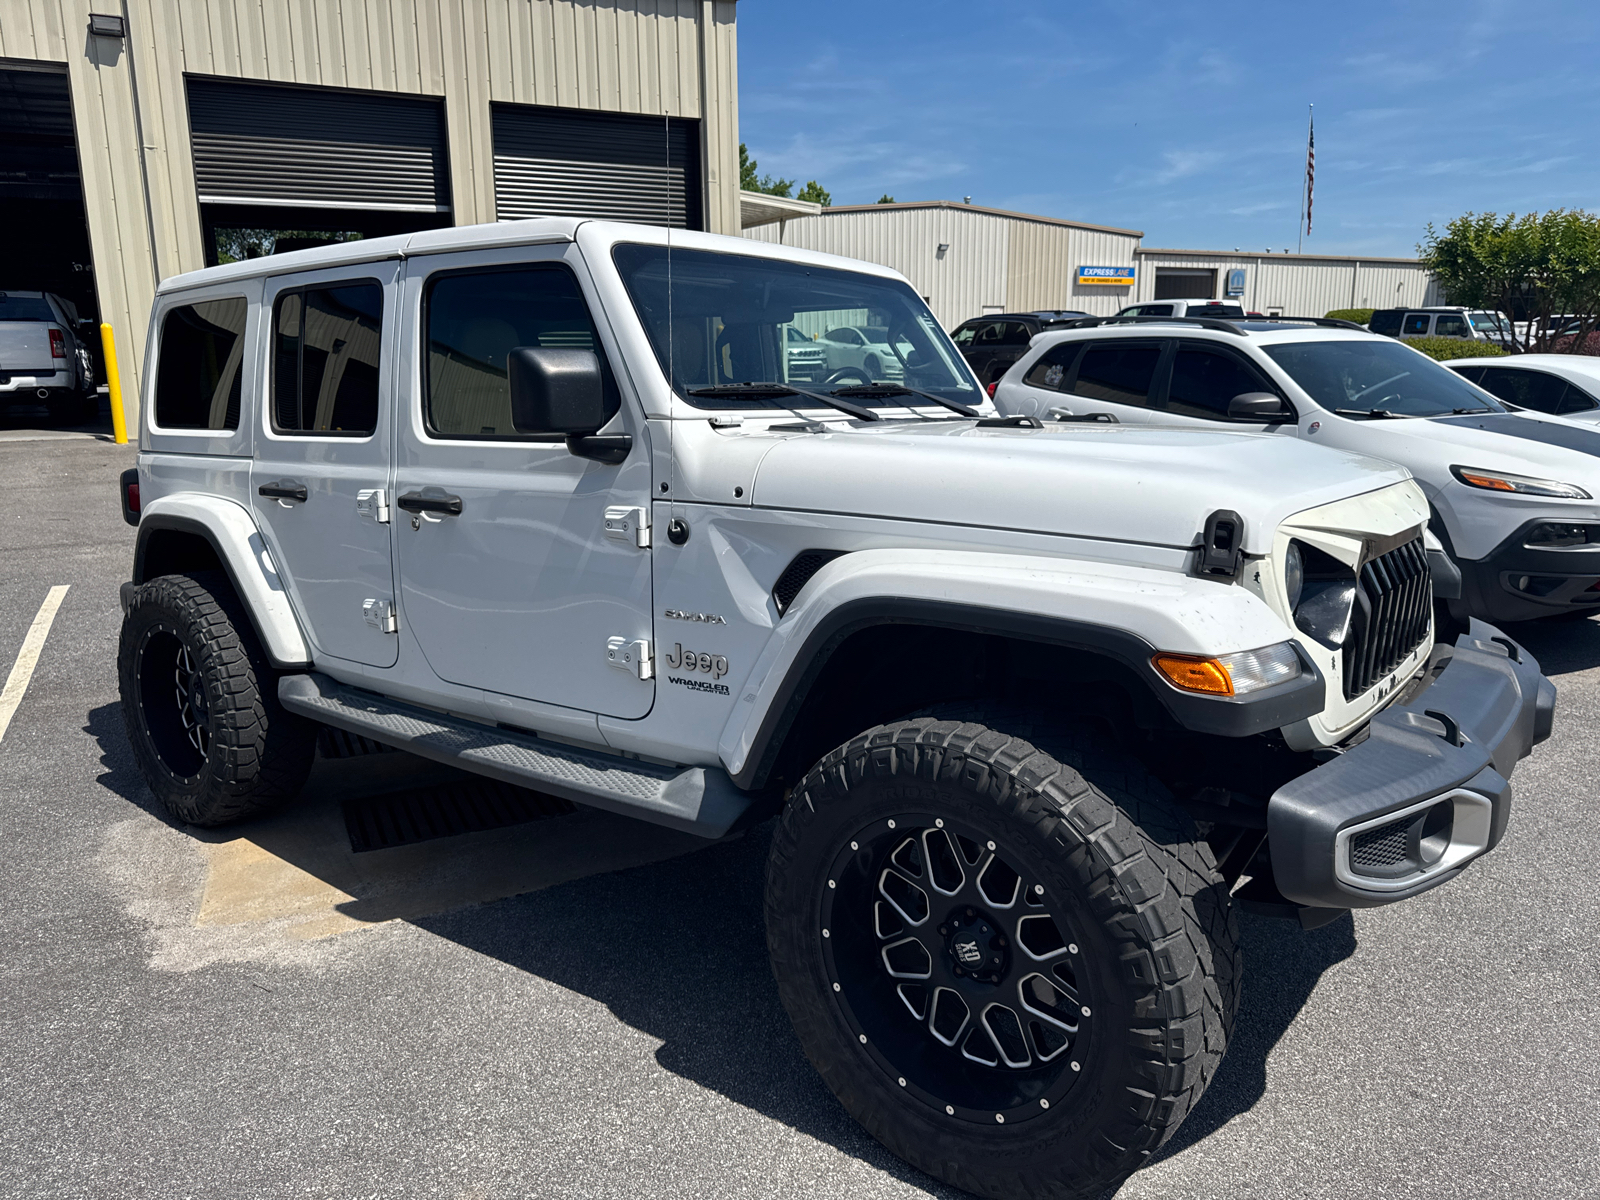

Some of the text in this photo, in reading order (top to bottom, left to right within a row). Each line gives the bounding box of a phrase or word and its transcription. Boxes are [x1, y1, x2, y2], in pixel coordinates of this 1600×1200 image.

[665, 608, 727, 625] SAHARA
[665, 642, 729, 680] Jeep
[668, 676, 730, 693] WRANGLER
[687, 685, 730, 696] UNLIMITED
